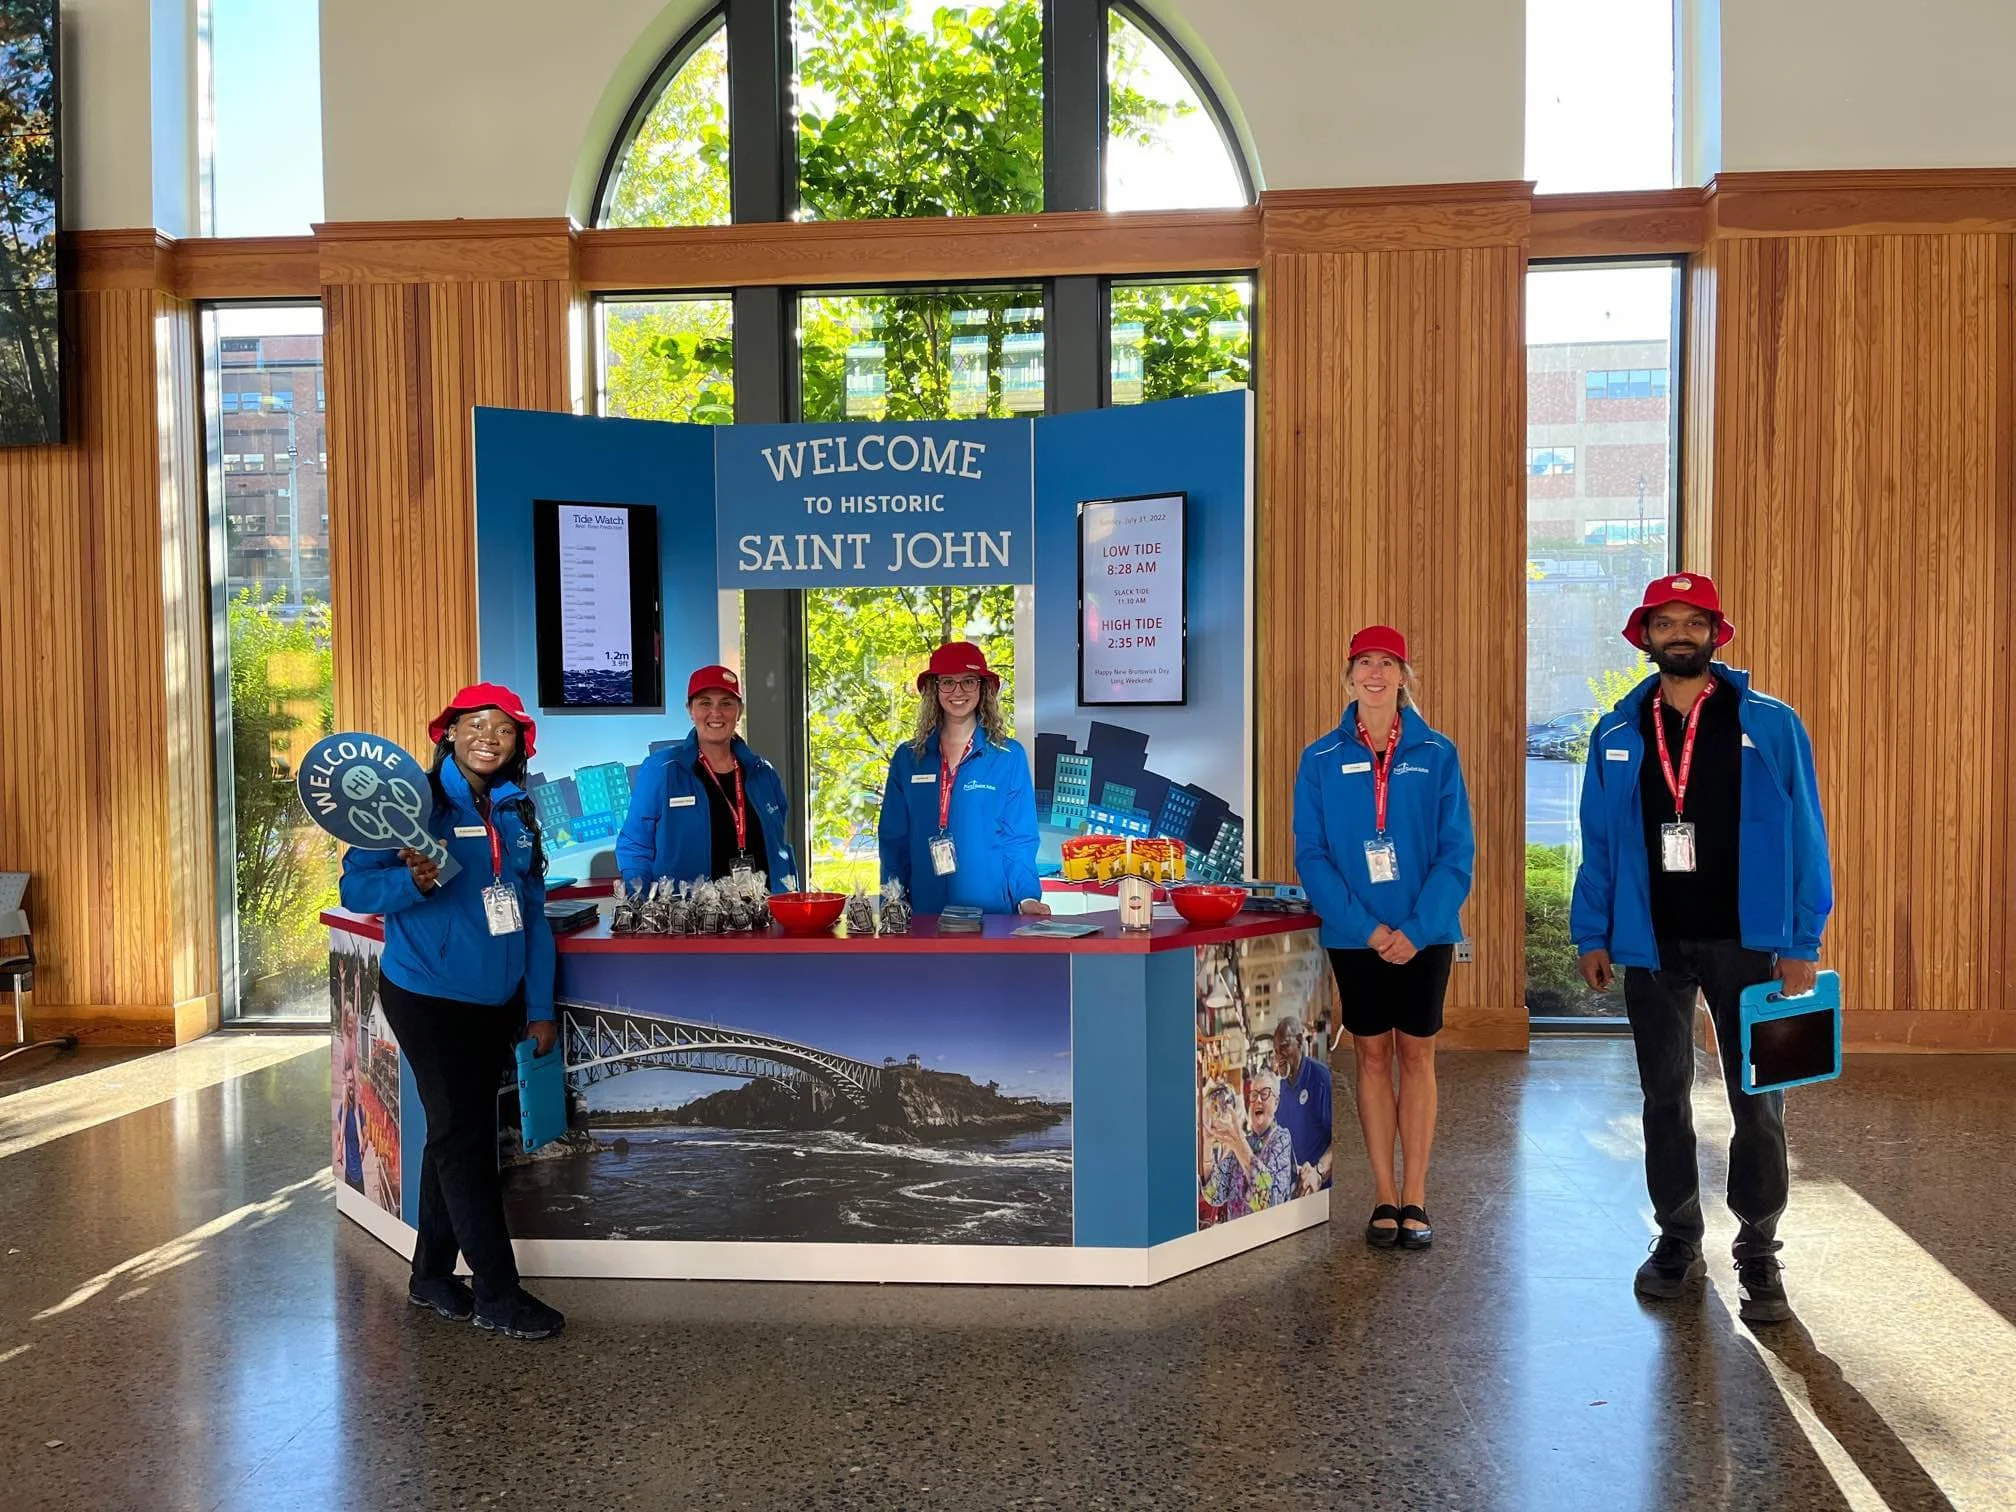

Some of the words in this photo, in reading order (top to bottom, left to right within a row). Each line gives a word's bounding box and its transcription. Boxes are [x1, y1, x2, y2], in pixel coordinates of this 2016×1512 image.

[761, 435, 986, 482] WELCOME
[803, 496, 832, 514] TO
[840, 494, 944, 513] HISTORIC
[573, 514, 593, 523] Tide
[595, 515, 624, 525] Watch
[738, 533, 871, 571] SAINT
[887, 531, 1011, 572] JOHN
[1103, 545, 1130, 557] LOW
[1134, 543, 1161, 555] TIDE
[1107, 564, 1132, 575] 8:28
[1136, 561, 1156, 573] AM
[1102, 619, 1131, 631] HIGH
[1136, 617, 1163, 629] TIDE
[1107, 637, 1132, 649] 2:35
[1137, 636, 1156, 648] PM
[605, 651, 629, 660] 1.2m
[309, 741, 402, 815] WELCOME
[346, 769, 375, 796] Hi!
